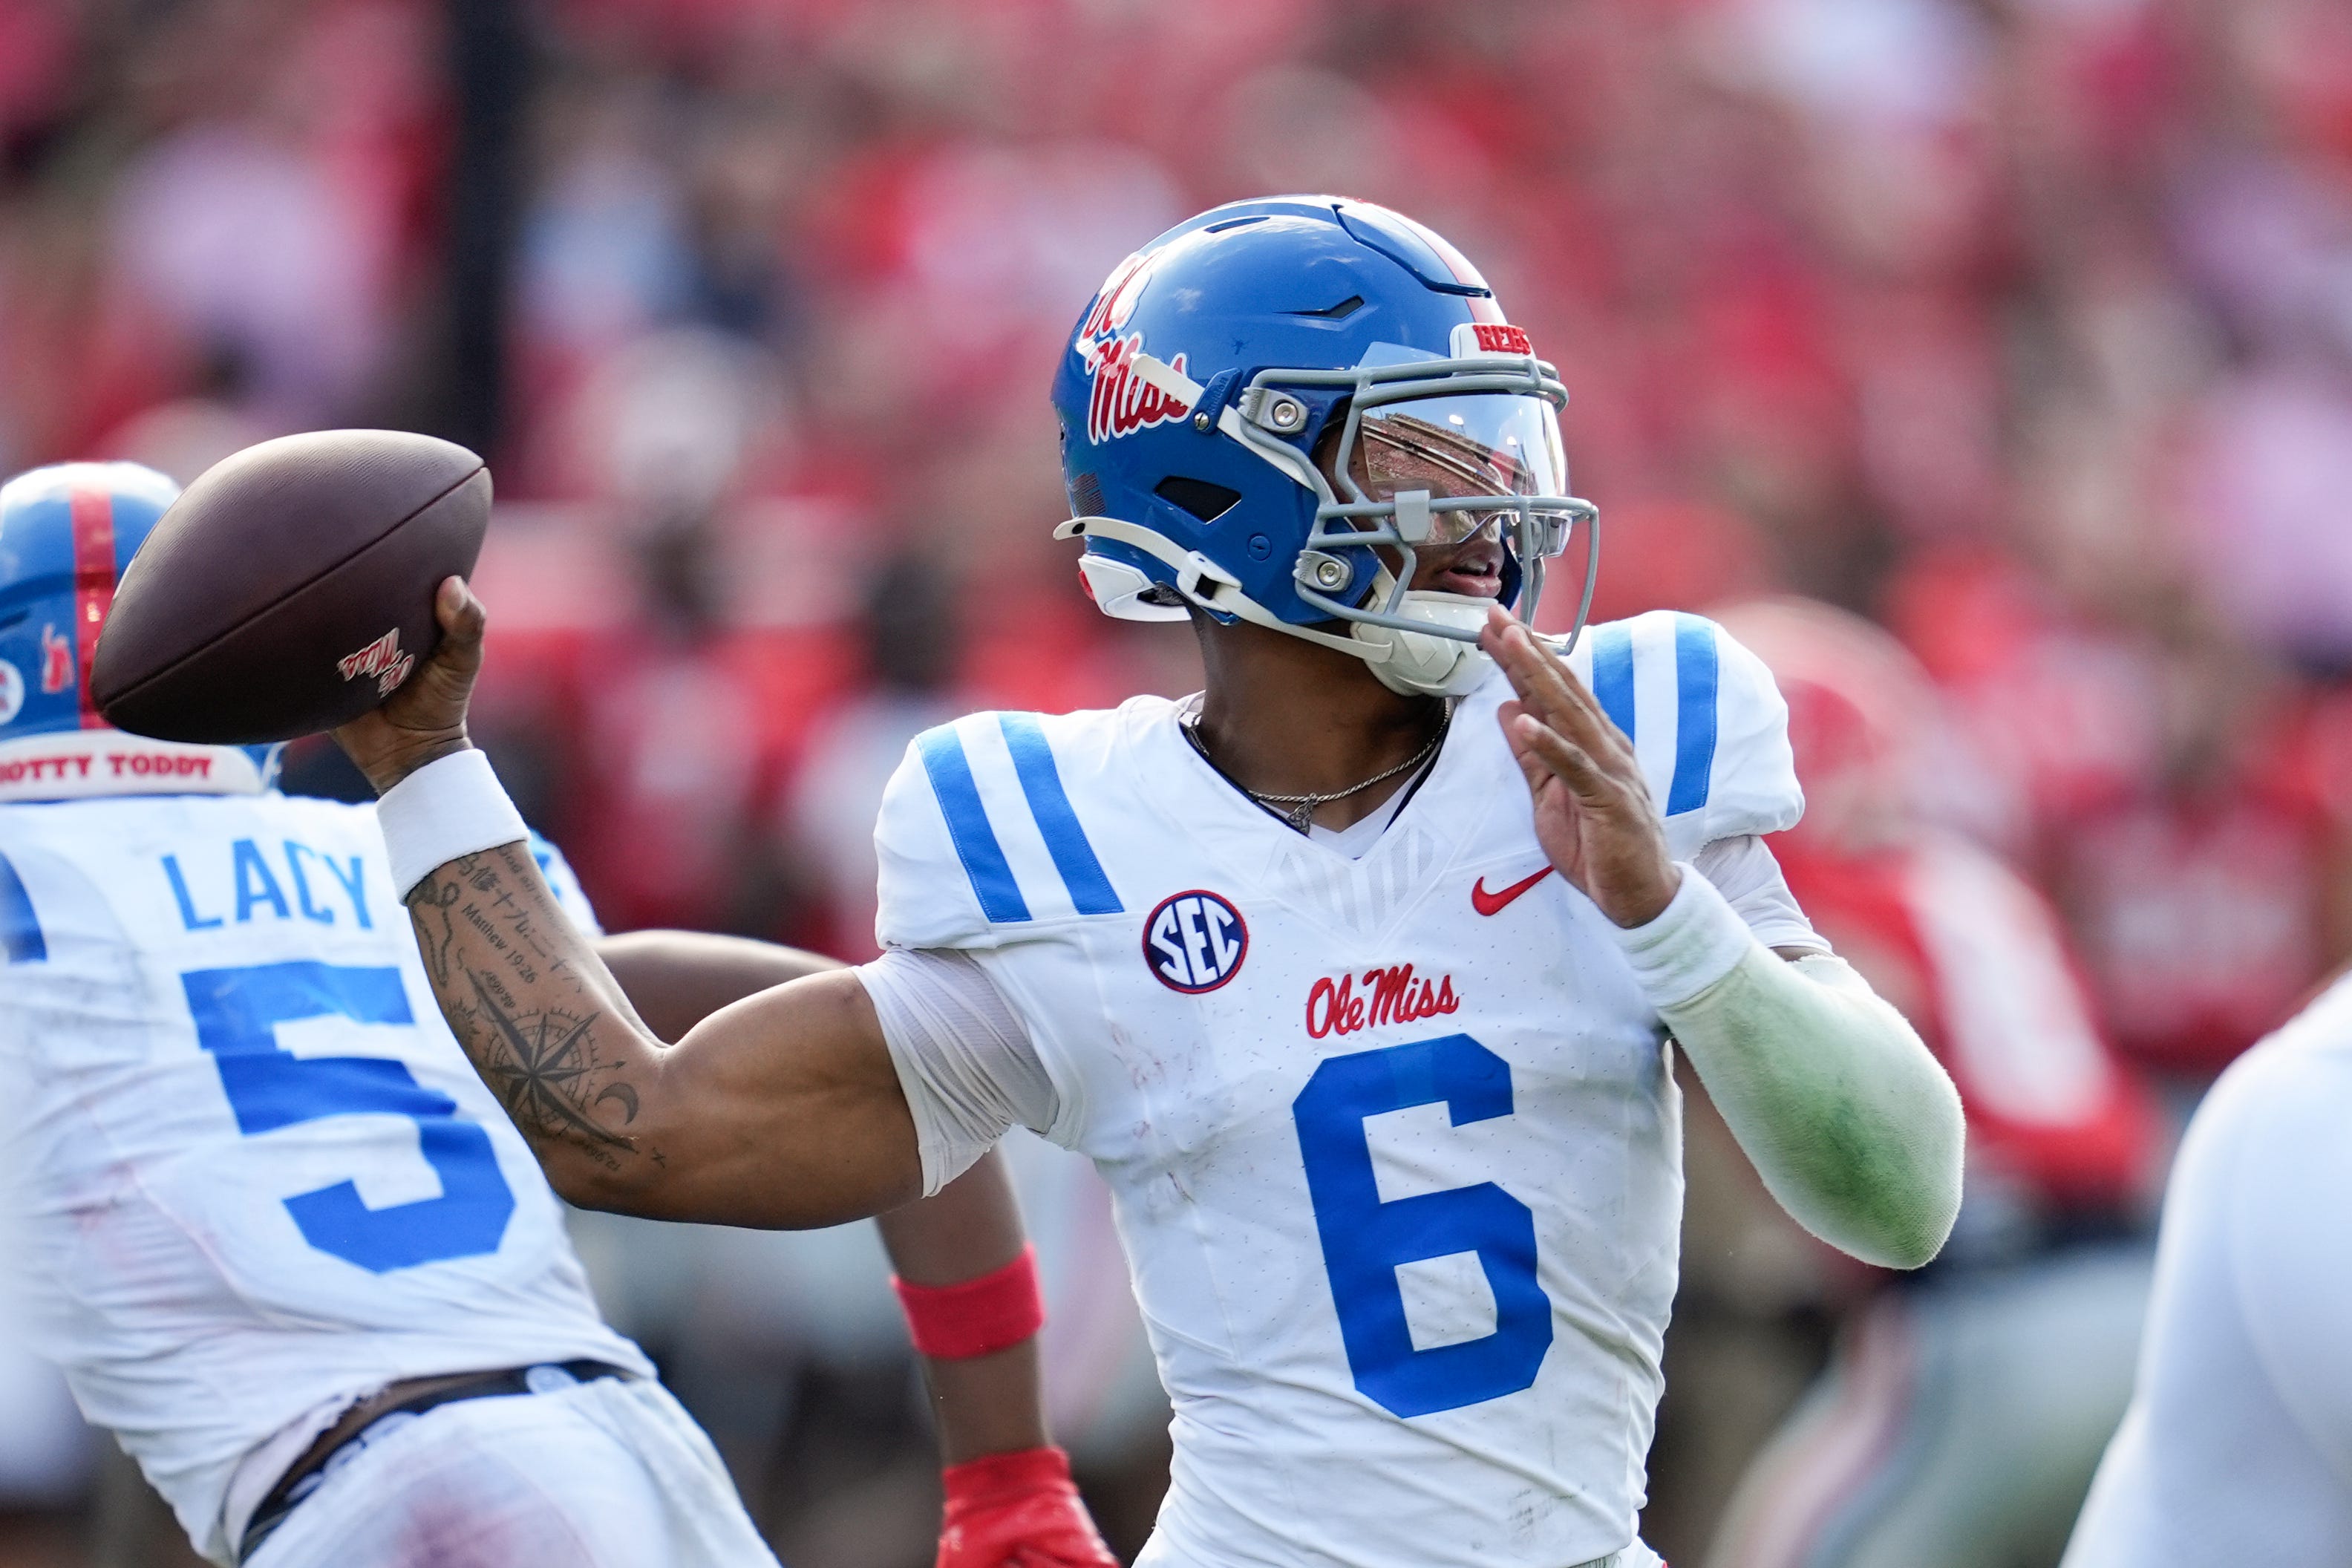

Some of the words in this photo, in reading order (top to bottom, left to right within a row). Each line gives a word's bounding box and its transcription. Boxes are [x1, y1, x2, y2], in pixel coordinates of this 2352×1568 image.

[0, 754, 92, 786] OTTY
[108, 754, 212, 779] TODDY
[160, 839, 374, 932] LACY
[462, 902, 508, 953] Matthew
[505, 947, 539, 985] 19:26
[1149, 897, 1242, 986] SEC
[1306, 973, 1365, 1039] Ole
[1362, 963, 1460, 1028] Miss
[180, 961, 517, 1274] 5
[1292, 1033, 1554, 1420] 6
